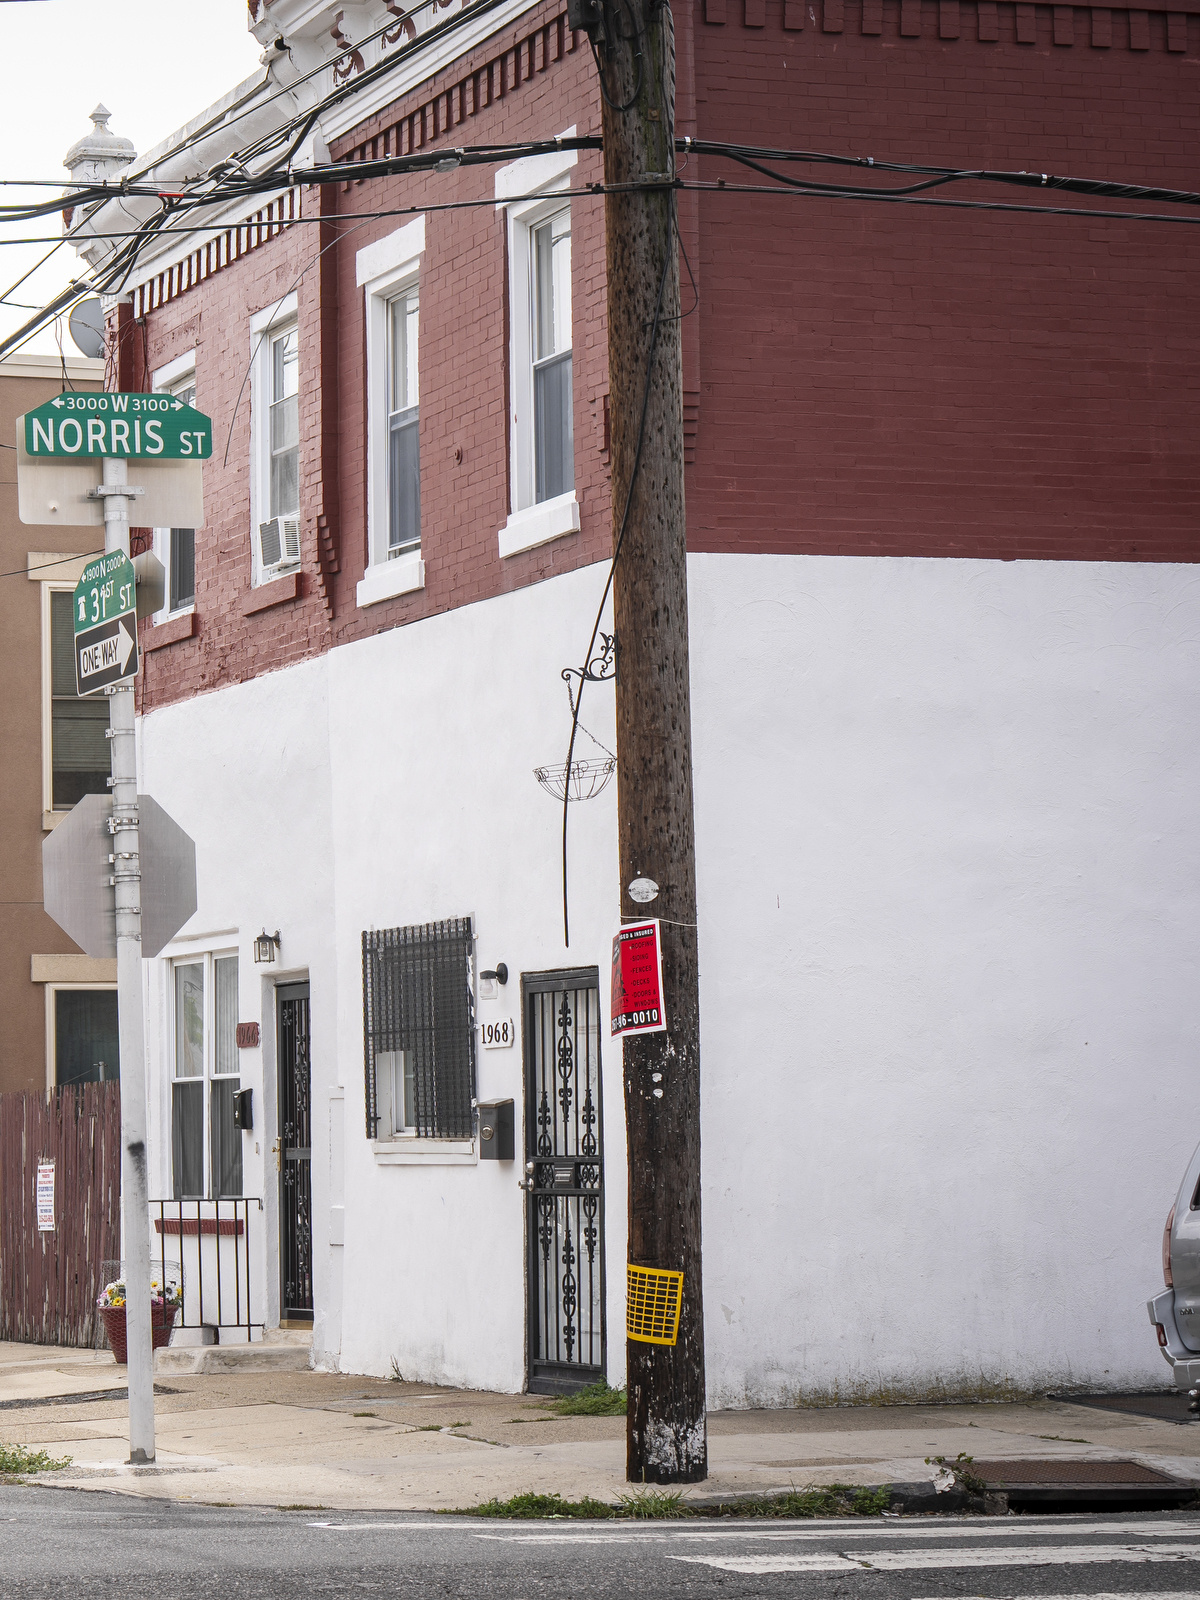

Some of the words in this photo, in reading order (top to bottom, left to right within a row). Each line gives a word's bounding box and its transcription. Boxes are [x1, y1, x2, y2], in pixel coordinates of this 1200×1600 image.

[66, 397, 108, 410] 3000
[111, 395, 129, 412] W
[132, 398, 169, 411] 3100
[32, 418, 164, 454] NORRIS
[180, 431, 206, 455] ST
[86, 565, 99, 581] 1900
[100, 560, 106, 578] N
[107, 555, 120, 572] 2000
[120, 582, 131, 610] ST
[82, 646, 99, 673] ONE
[101, 638, 118, 666] WAY
[634, 928, 653, 937] INSURED
[481, 1022, 508, 1044] 1968
